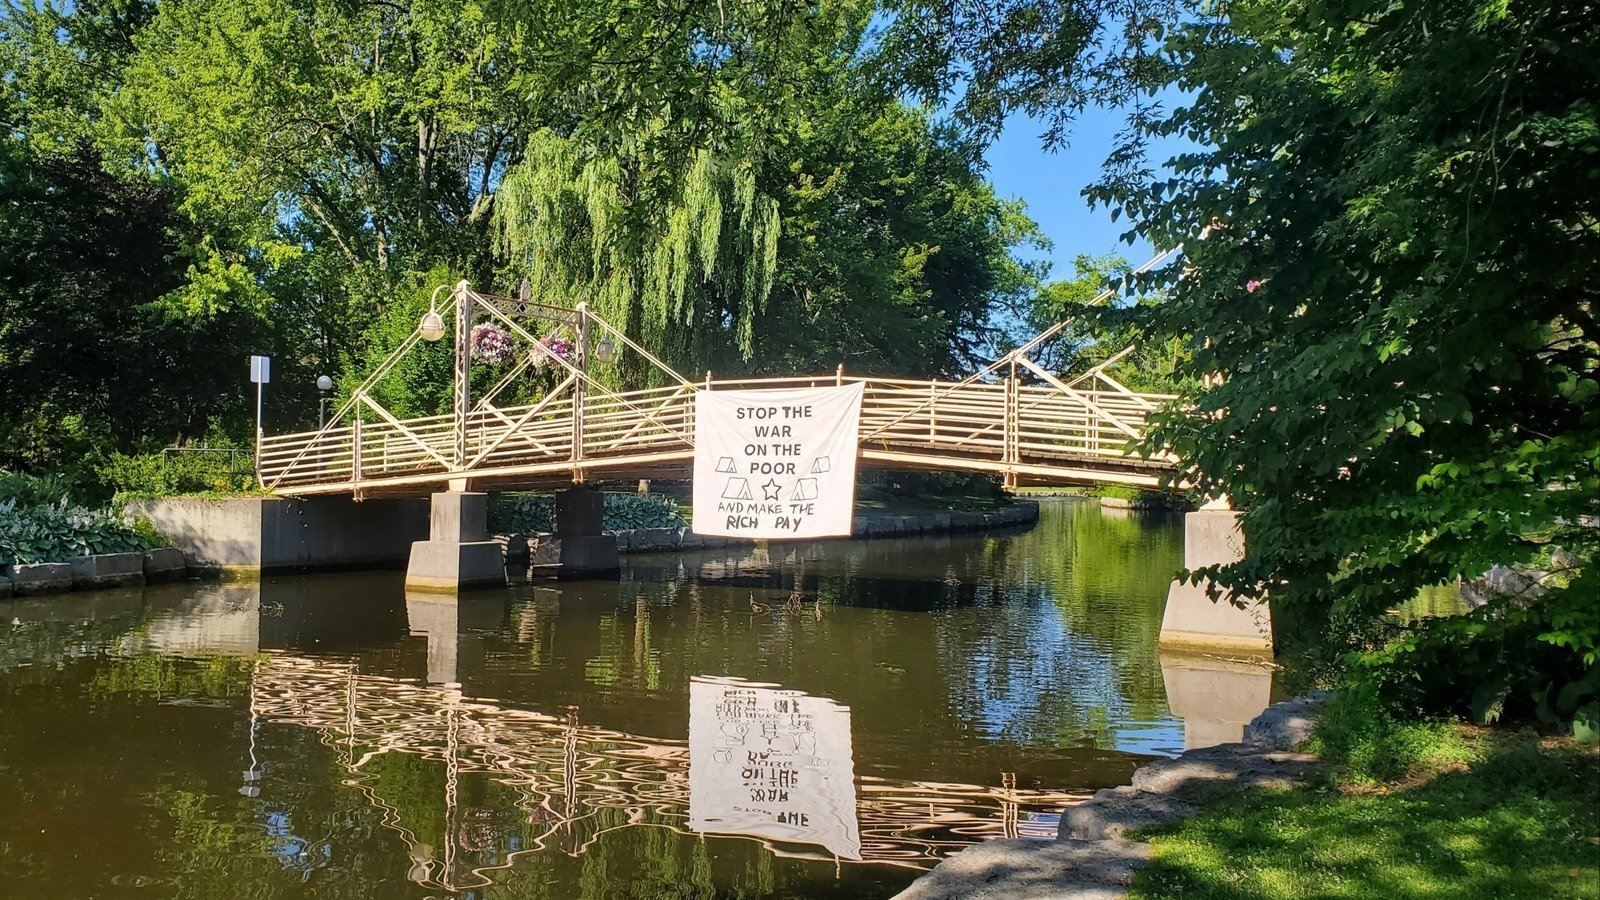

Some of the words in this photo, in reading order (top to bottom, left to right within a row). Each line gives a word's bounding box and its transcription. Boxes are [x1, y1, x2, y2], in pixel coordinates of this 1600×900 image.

[736, 407, 778, 419] STOP
[782, 406, 812, 418] THE
[755, 426, 792, 438] WAR
[745, 444, 767, 456] ON
[772, 444, 802, 456] THE
[750, 462, 796, 474] POOR
[718, 502, 744, 513] AND
[747, 502, 783, 515] MAKE
[790, 503, 815, 515] THE
[726, 516, 759, 530] RICH
[775, 517, 802, 532] PAY
